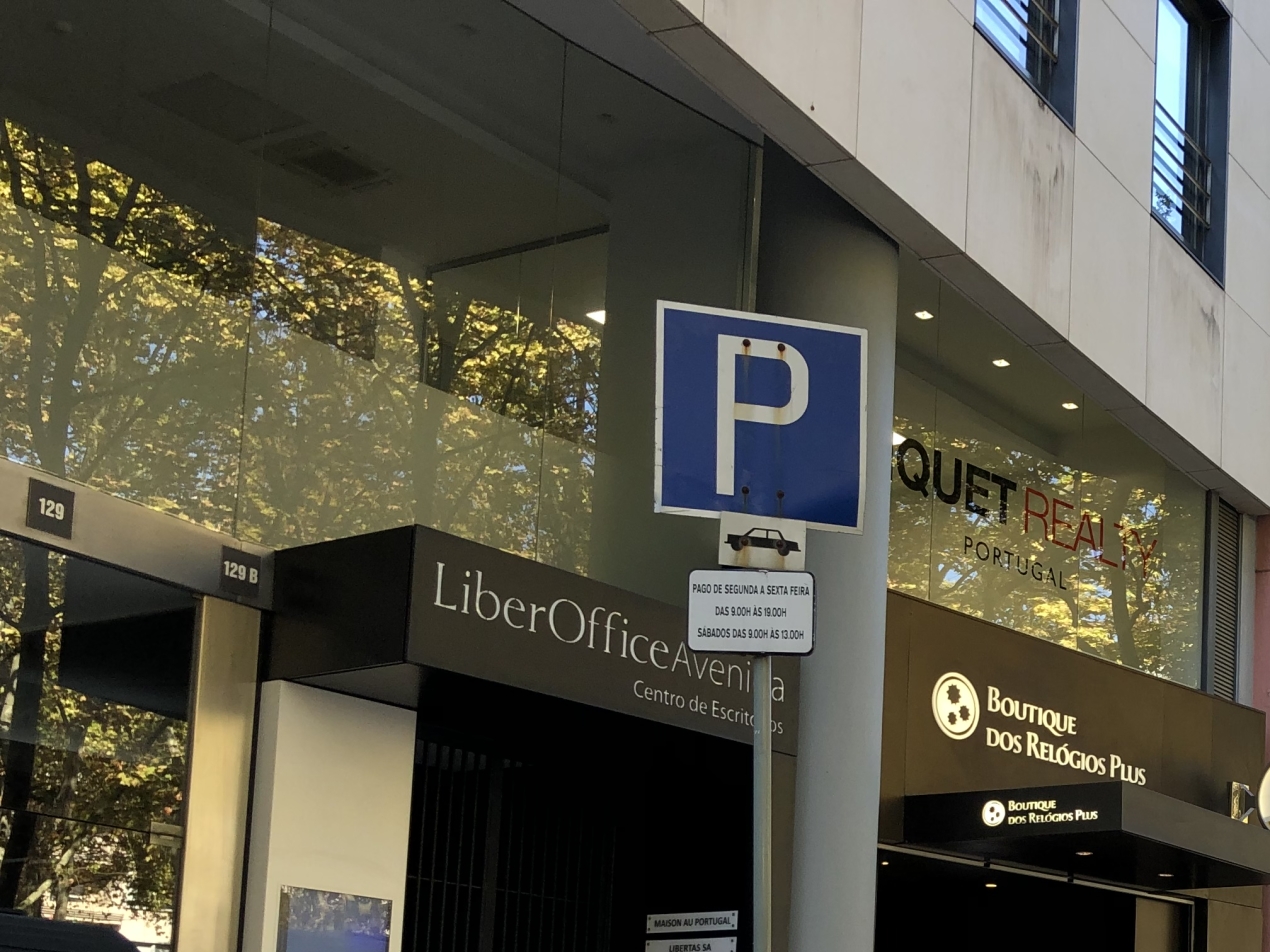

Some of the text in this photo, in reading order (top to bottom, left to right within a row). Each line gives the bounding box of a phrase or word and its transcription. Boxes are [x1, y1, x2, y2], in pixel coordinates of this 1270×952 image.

[716, 333, 809, 496] P
[38, 497, 65, 521] 129
[891, 438, 1158, 580] QUET REALTY
[223, 560, 258, 584] 129 B
[964, 535, 1067, 591] PORTUGAL
[692, 583, 810, 596] PAGO DE SEGUNDA A SEXTA FEIRA
[715, 604, 787, 618] DAS 9.00H ÀS 19.00H
[434, 561, 785, 702] LiberOfficeAvenia
[697, 625, 805, 640] SÁBADOS DAS 9.00H ÀS 13.00H
[633, 680, 685, 709] Centro
[688, 695, 708, 715] de
[1109, 753, 1147, 786] PLUS
[1075, 809, 1098, 821] PLUS
[654, 916, 731, 928] MAISON AU PORTUGAL
[669, 943, 712, 952] LIBERTAS SA
